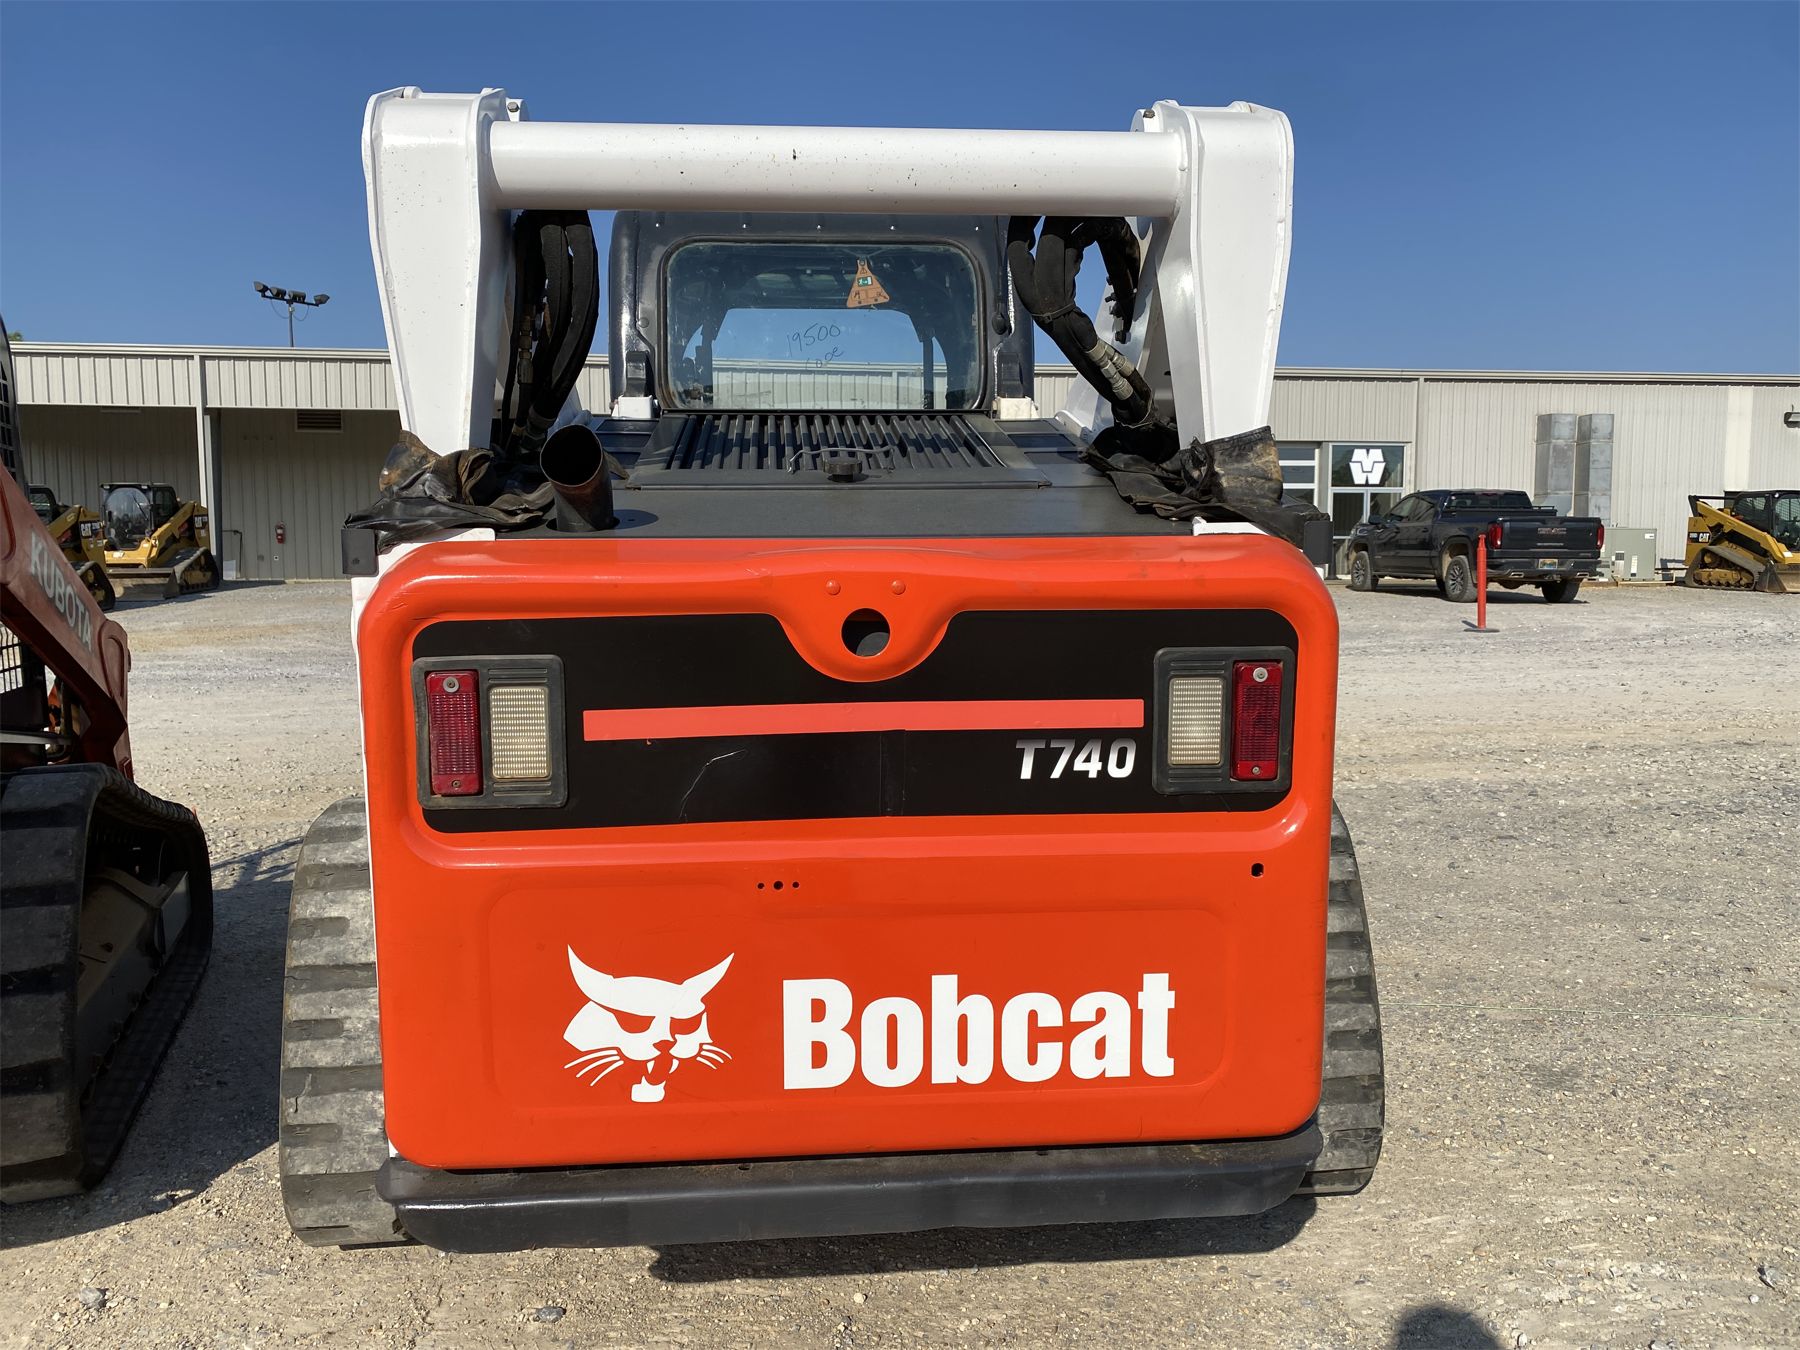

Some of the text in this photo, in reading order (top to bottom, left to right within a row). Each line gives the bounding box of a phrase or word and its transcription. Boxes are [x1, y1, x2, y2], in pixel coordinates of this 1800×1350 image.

[786, 322, 841, 357] 19500
[80, 523, 92, 537] CAT
[1698, 532, 1710, 543] CAT
[30, 531, 93, 651] KUBOTA
[1015, 738, 1137, 780] T740
[782, 972, 1176, 1090] Bobcat
